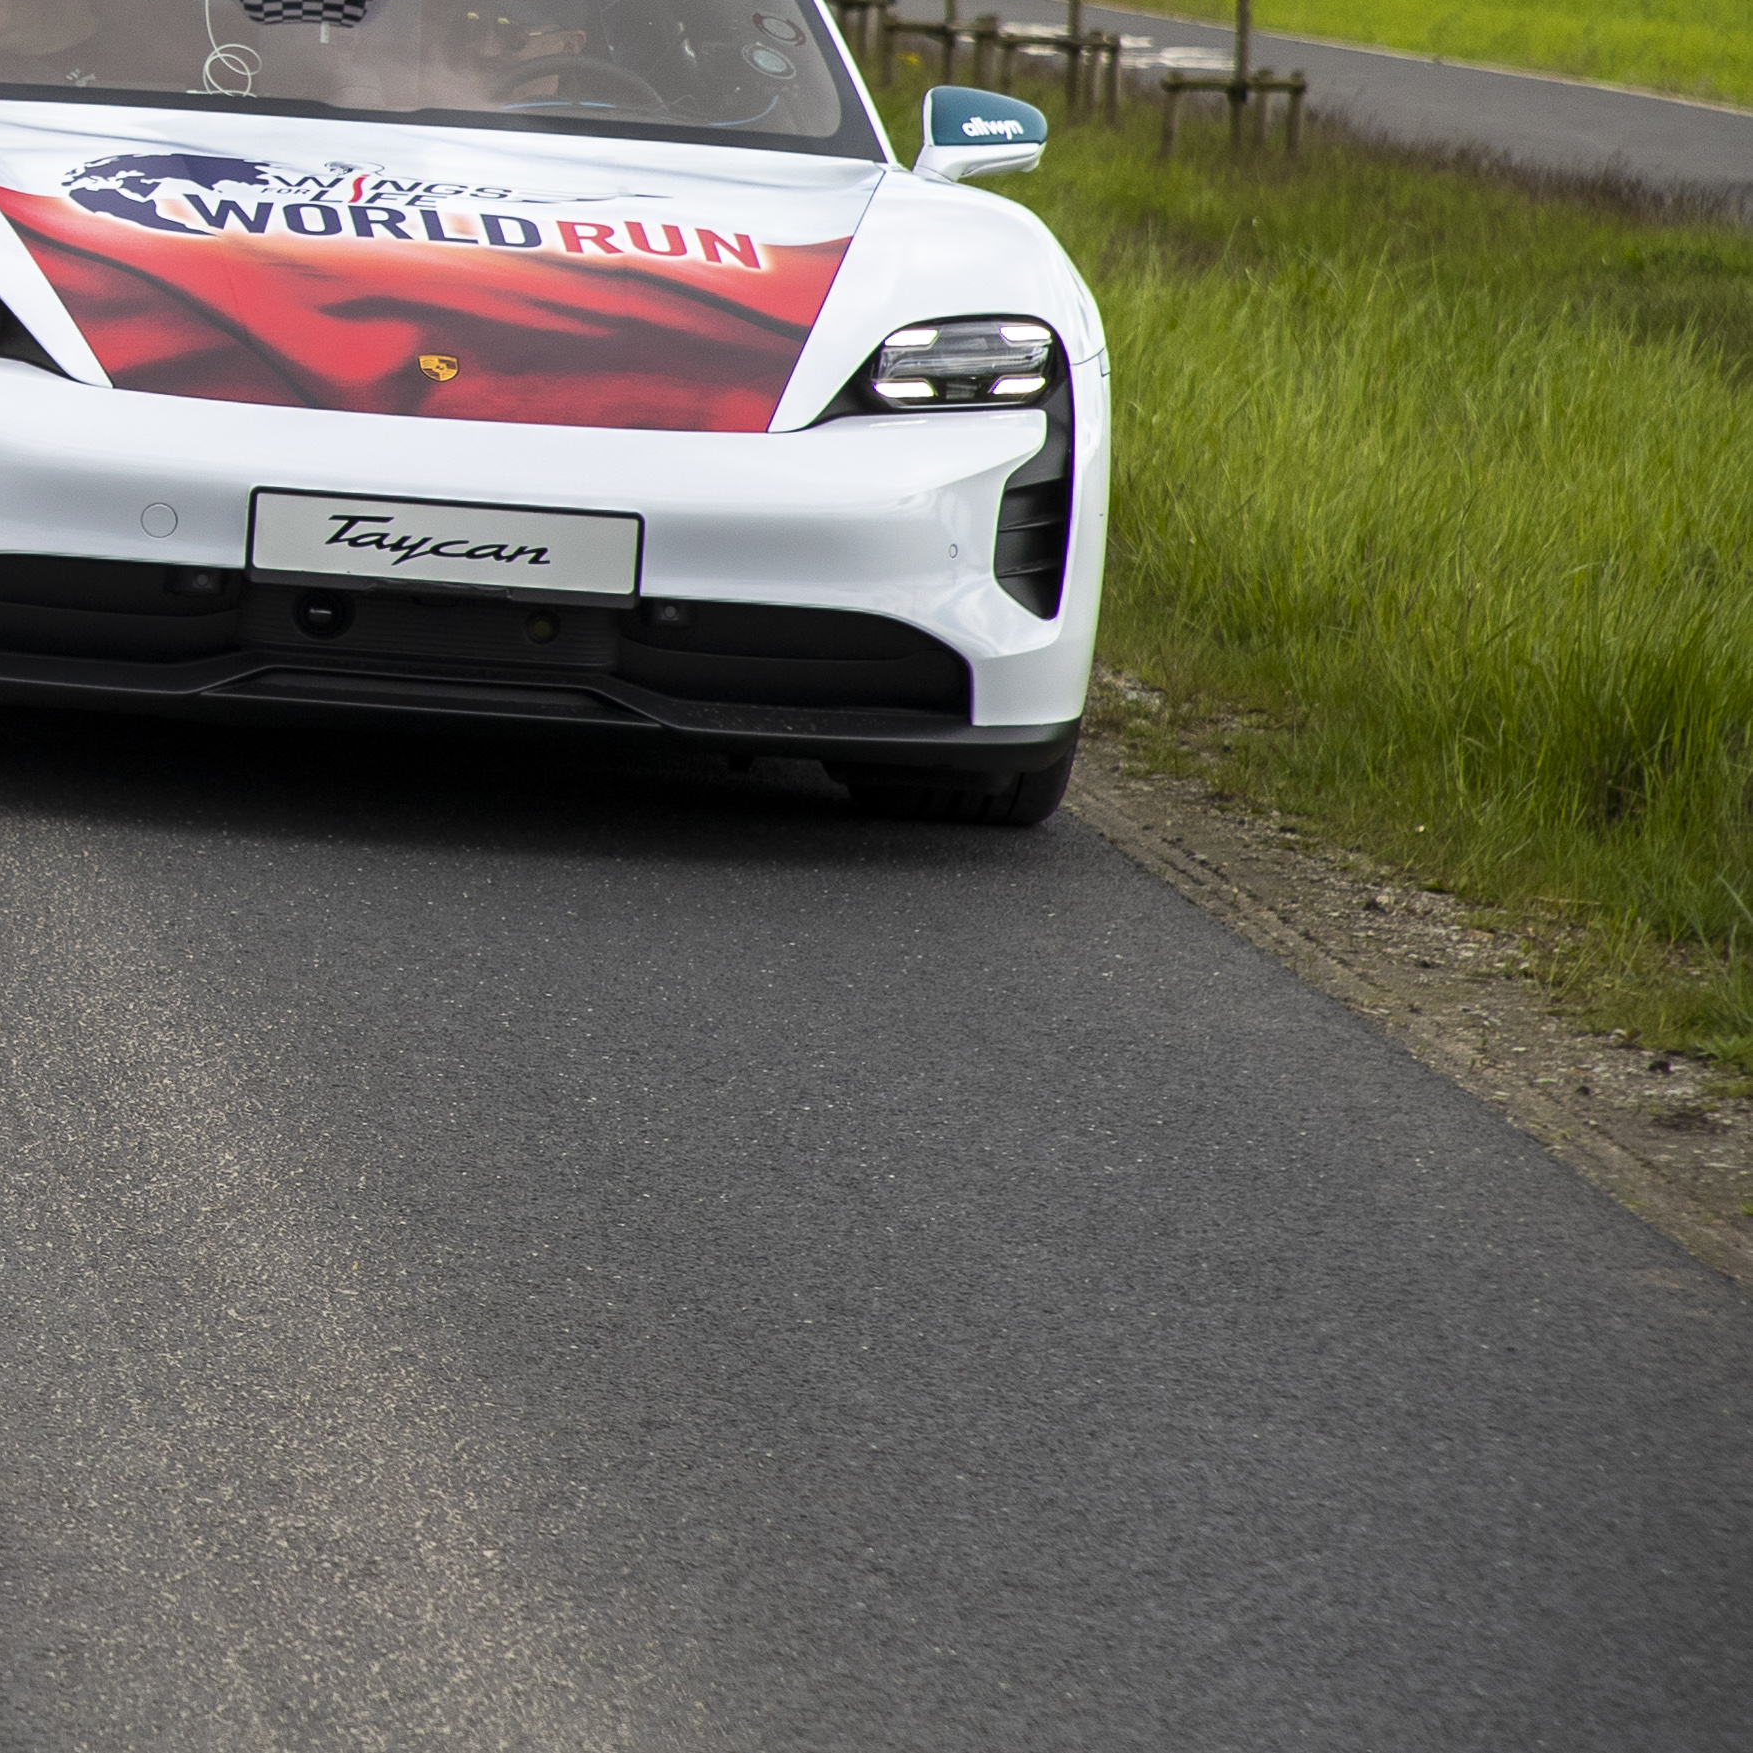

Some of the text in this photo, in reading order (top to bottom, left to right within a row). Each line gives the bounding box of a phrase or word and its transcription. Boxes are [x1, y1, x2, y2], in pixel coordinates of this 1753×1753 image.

[260, 186, 457, 208] FOR LIFE
[271, 174, 513, 200] WINGS
[183, 192, 762, 270] WORLD RUN
[324, 514, 551, 566] Taycan
